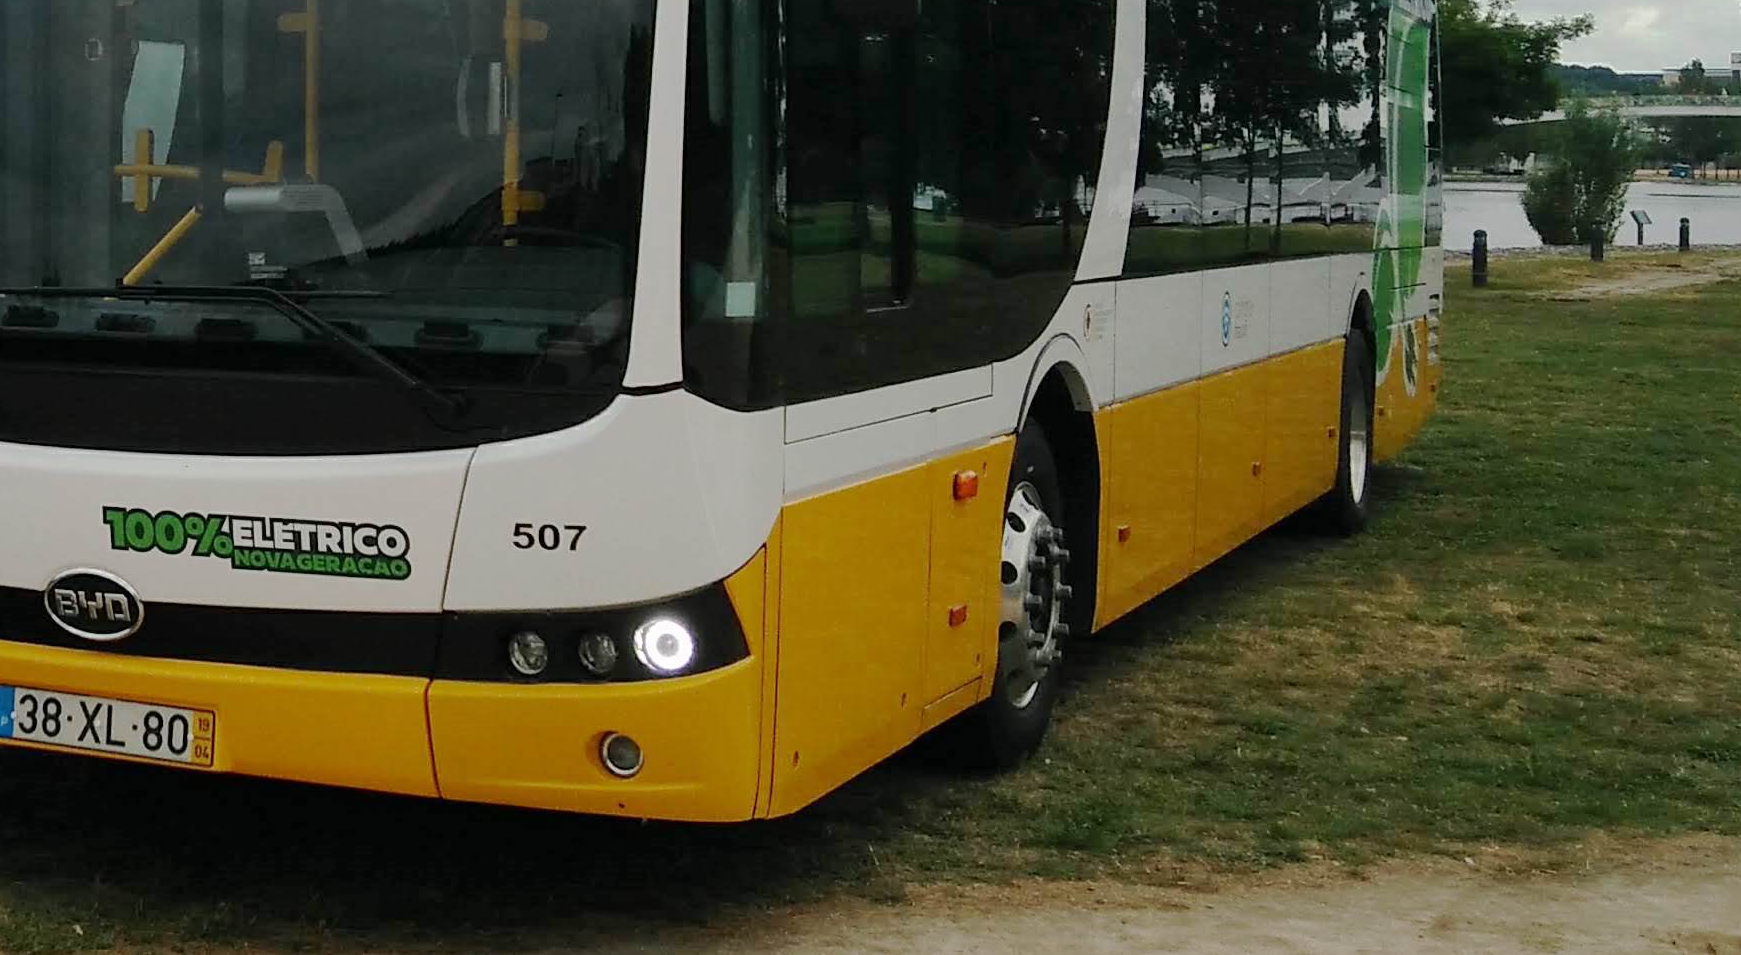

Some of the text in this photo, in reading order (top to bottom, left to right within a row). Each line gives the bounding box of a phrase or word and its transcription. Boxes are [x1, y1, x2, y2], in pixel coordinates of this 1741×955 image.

[104, 508, 233, 557] 100%
[511, 523, 589, 551] 507
[54, 587, 132, 624] BYD
[197, 717, 210, 732] 19
[194, 743, 210, 759] 04
